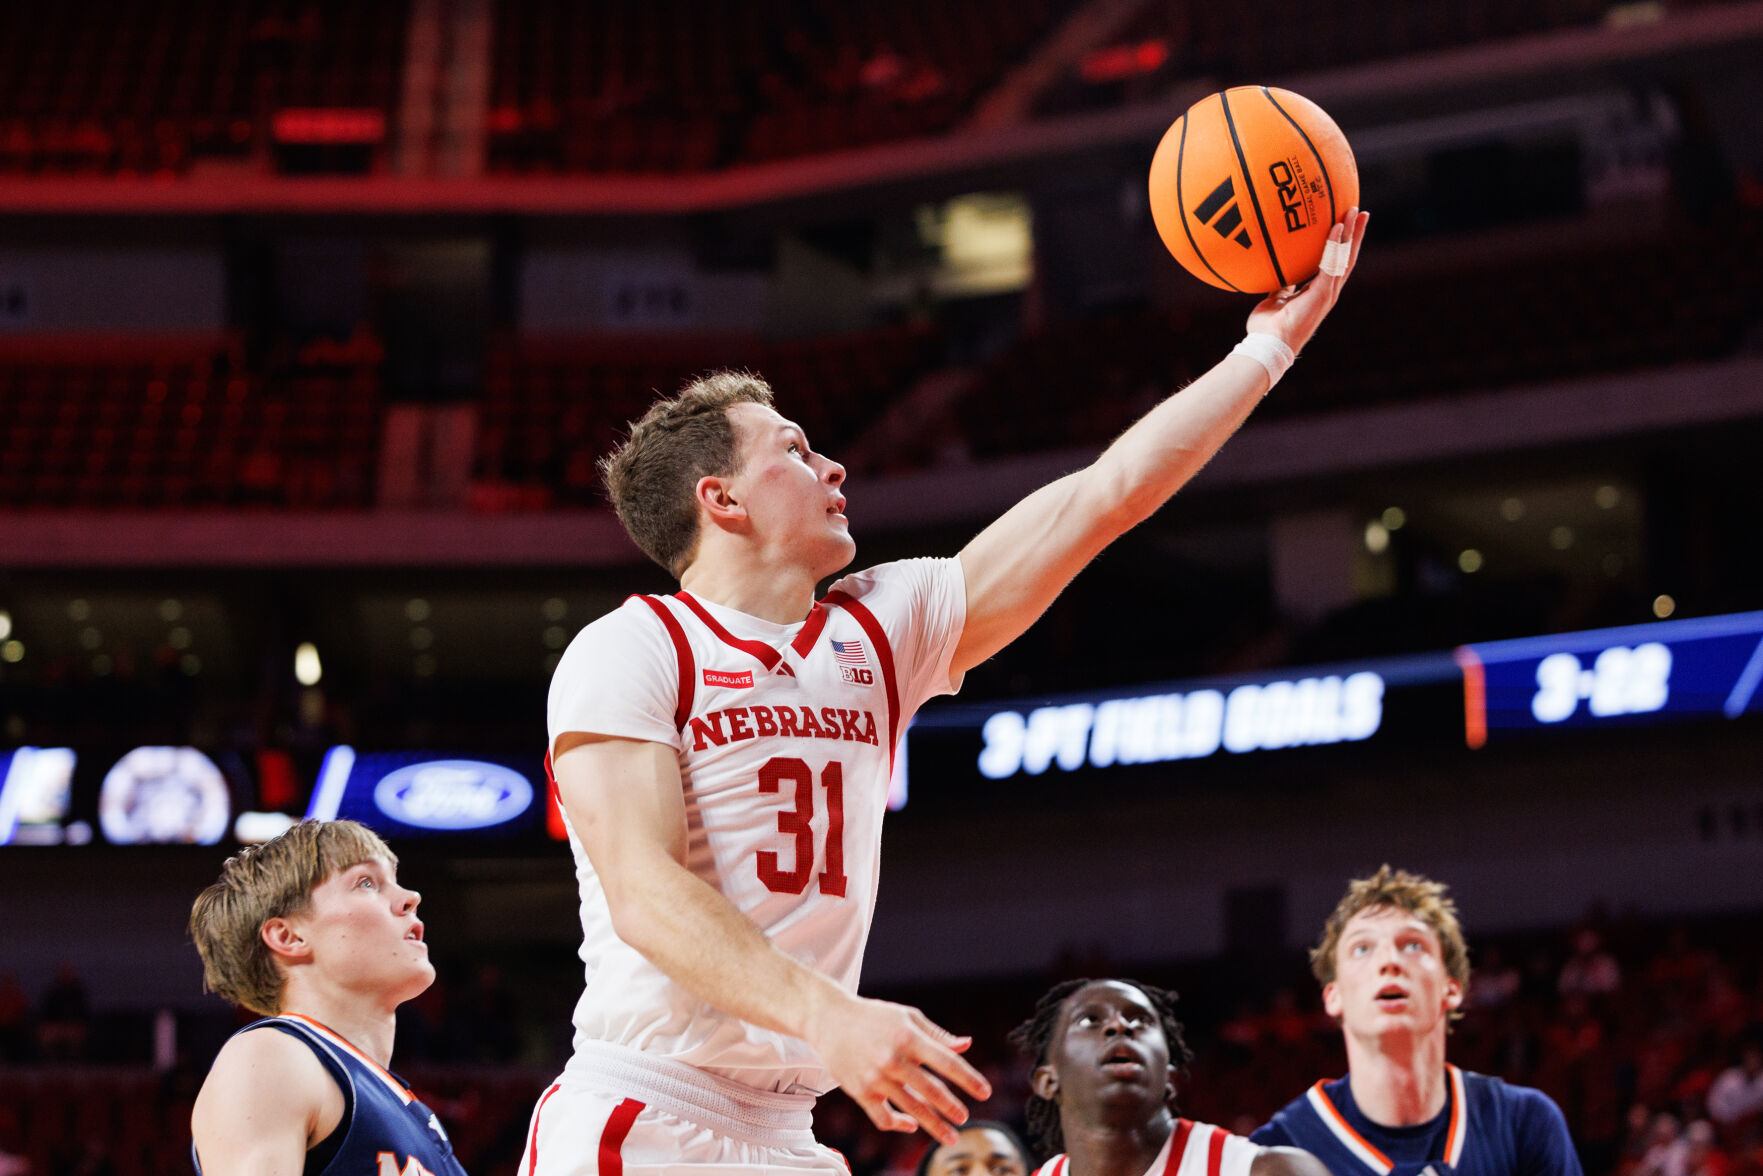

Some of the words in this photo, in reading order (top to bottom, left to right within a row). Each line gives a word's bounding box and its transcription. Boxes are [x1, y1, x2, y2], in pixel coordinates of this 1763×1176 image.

[1292, 155, 1302, 174] BALL
[1299, 174, 1310, 194] GAME
[1269, 161, 1306, 232] PRO
[705, 673, 752, 686] GRADUATE
[688, 705, 879, 752] NEBRASKA
[978, 702, 1095, 780] 3-PT
[1089, 688, 1226, 769] FIELD
[1222, 671, 1386, 754] GOALS
[756, 757, 848, 898] 31
